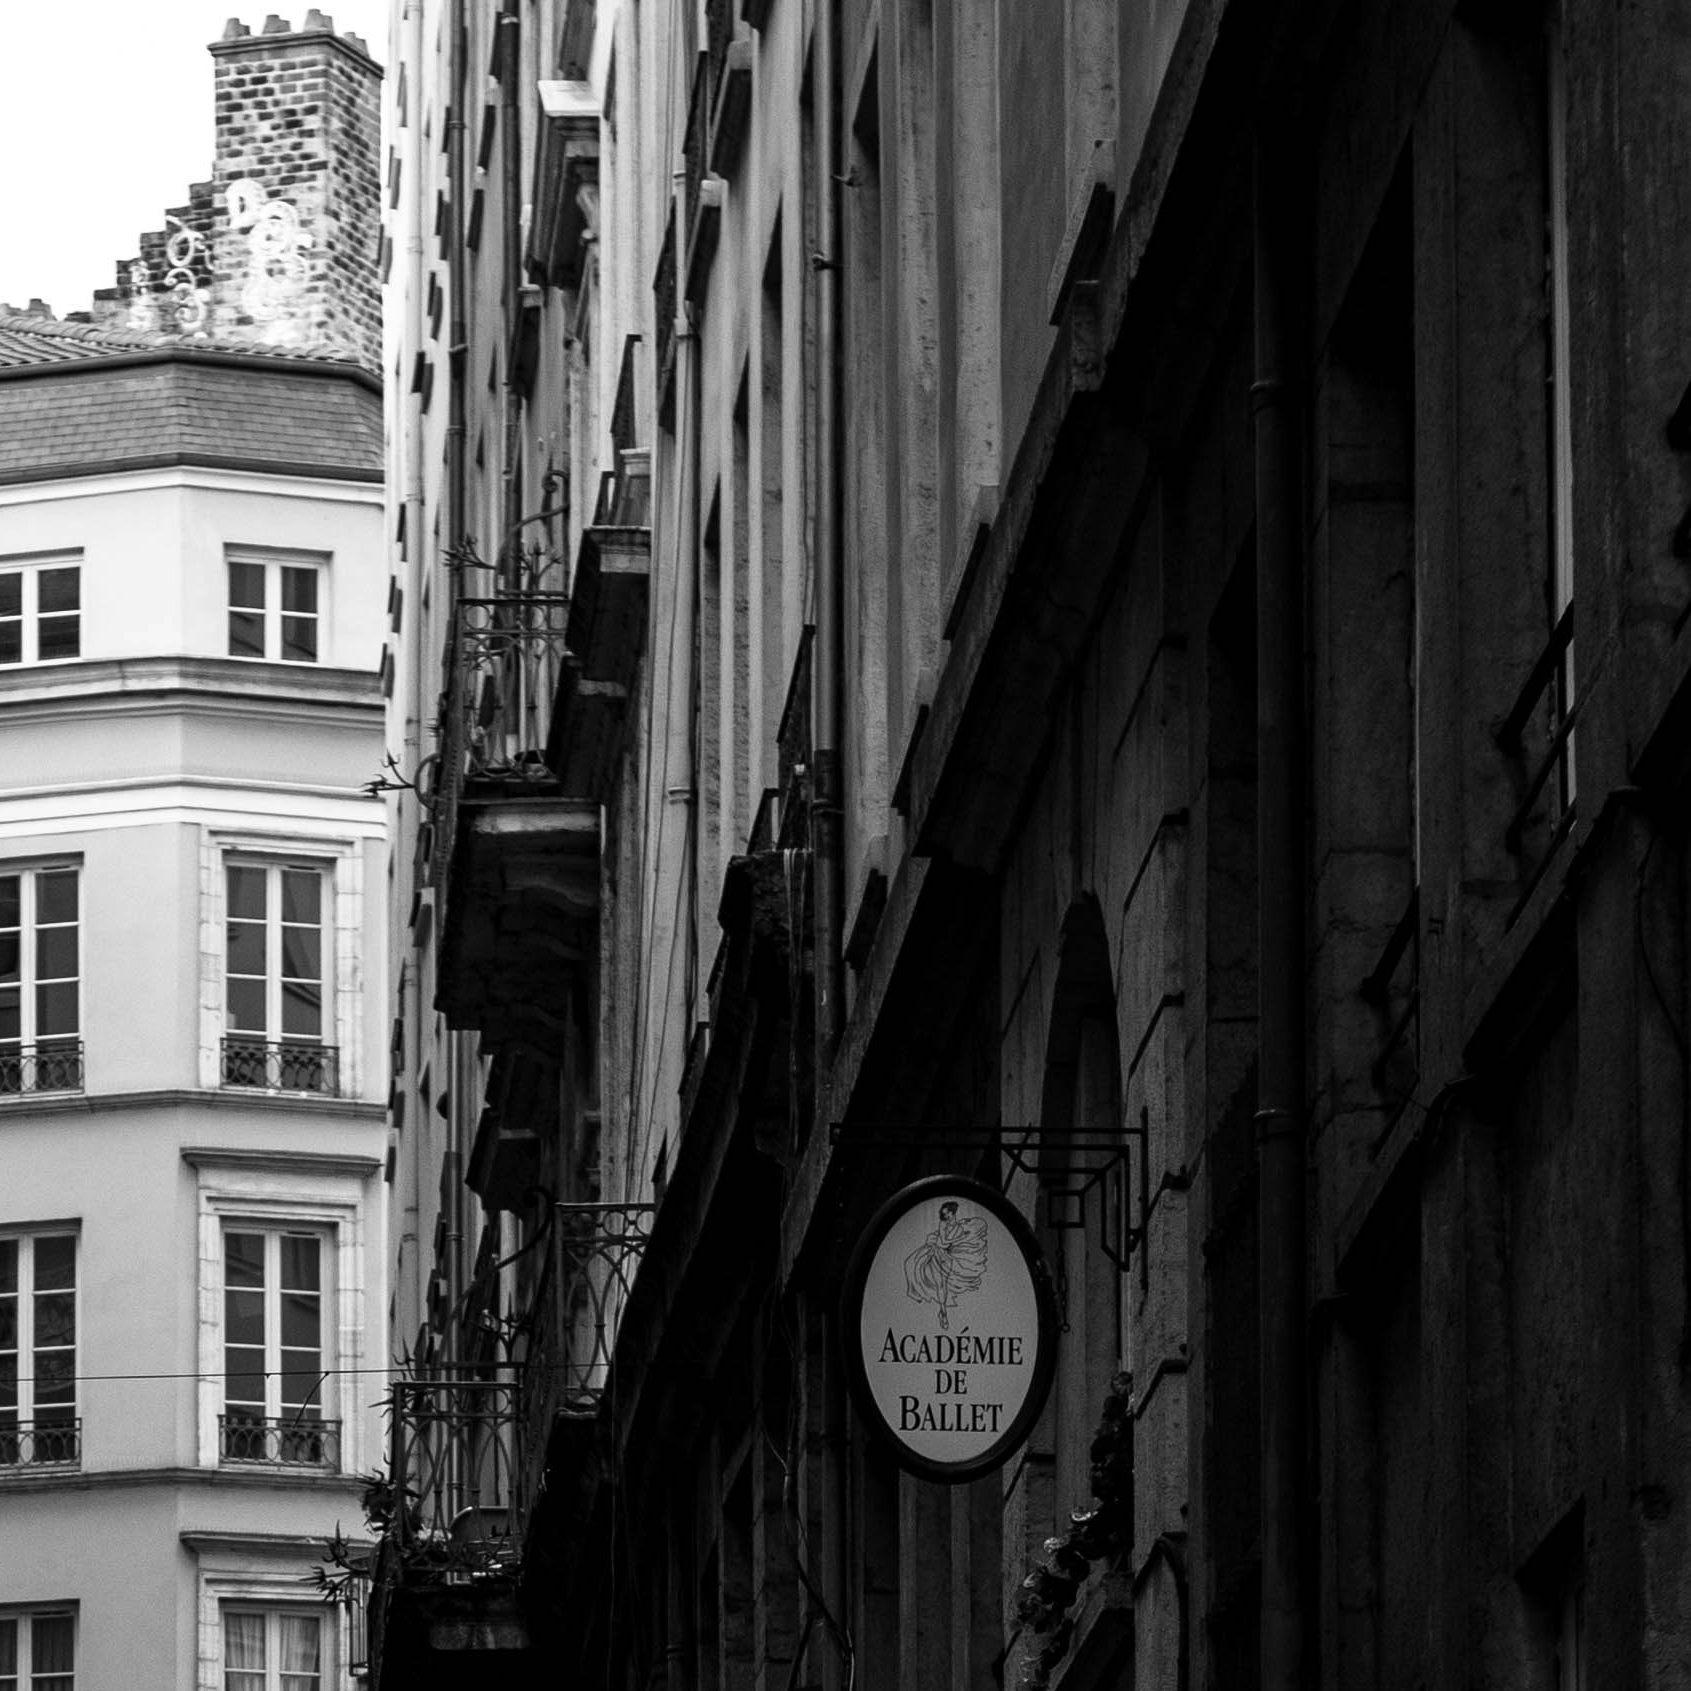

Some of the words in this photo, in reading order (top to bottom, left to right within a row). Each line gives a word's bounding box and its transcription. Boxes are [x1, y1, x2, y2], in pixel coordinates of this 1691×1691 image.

[877, 1326, 1023, 1365] ACADÉMIE
[934, 1369, 968, 1395] DE
[898, 1395, 1004, 1433] BALLET
